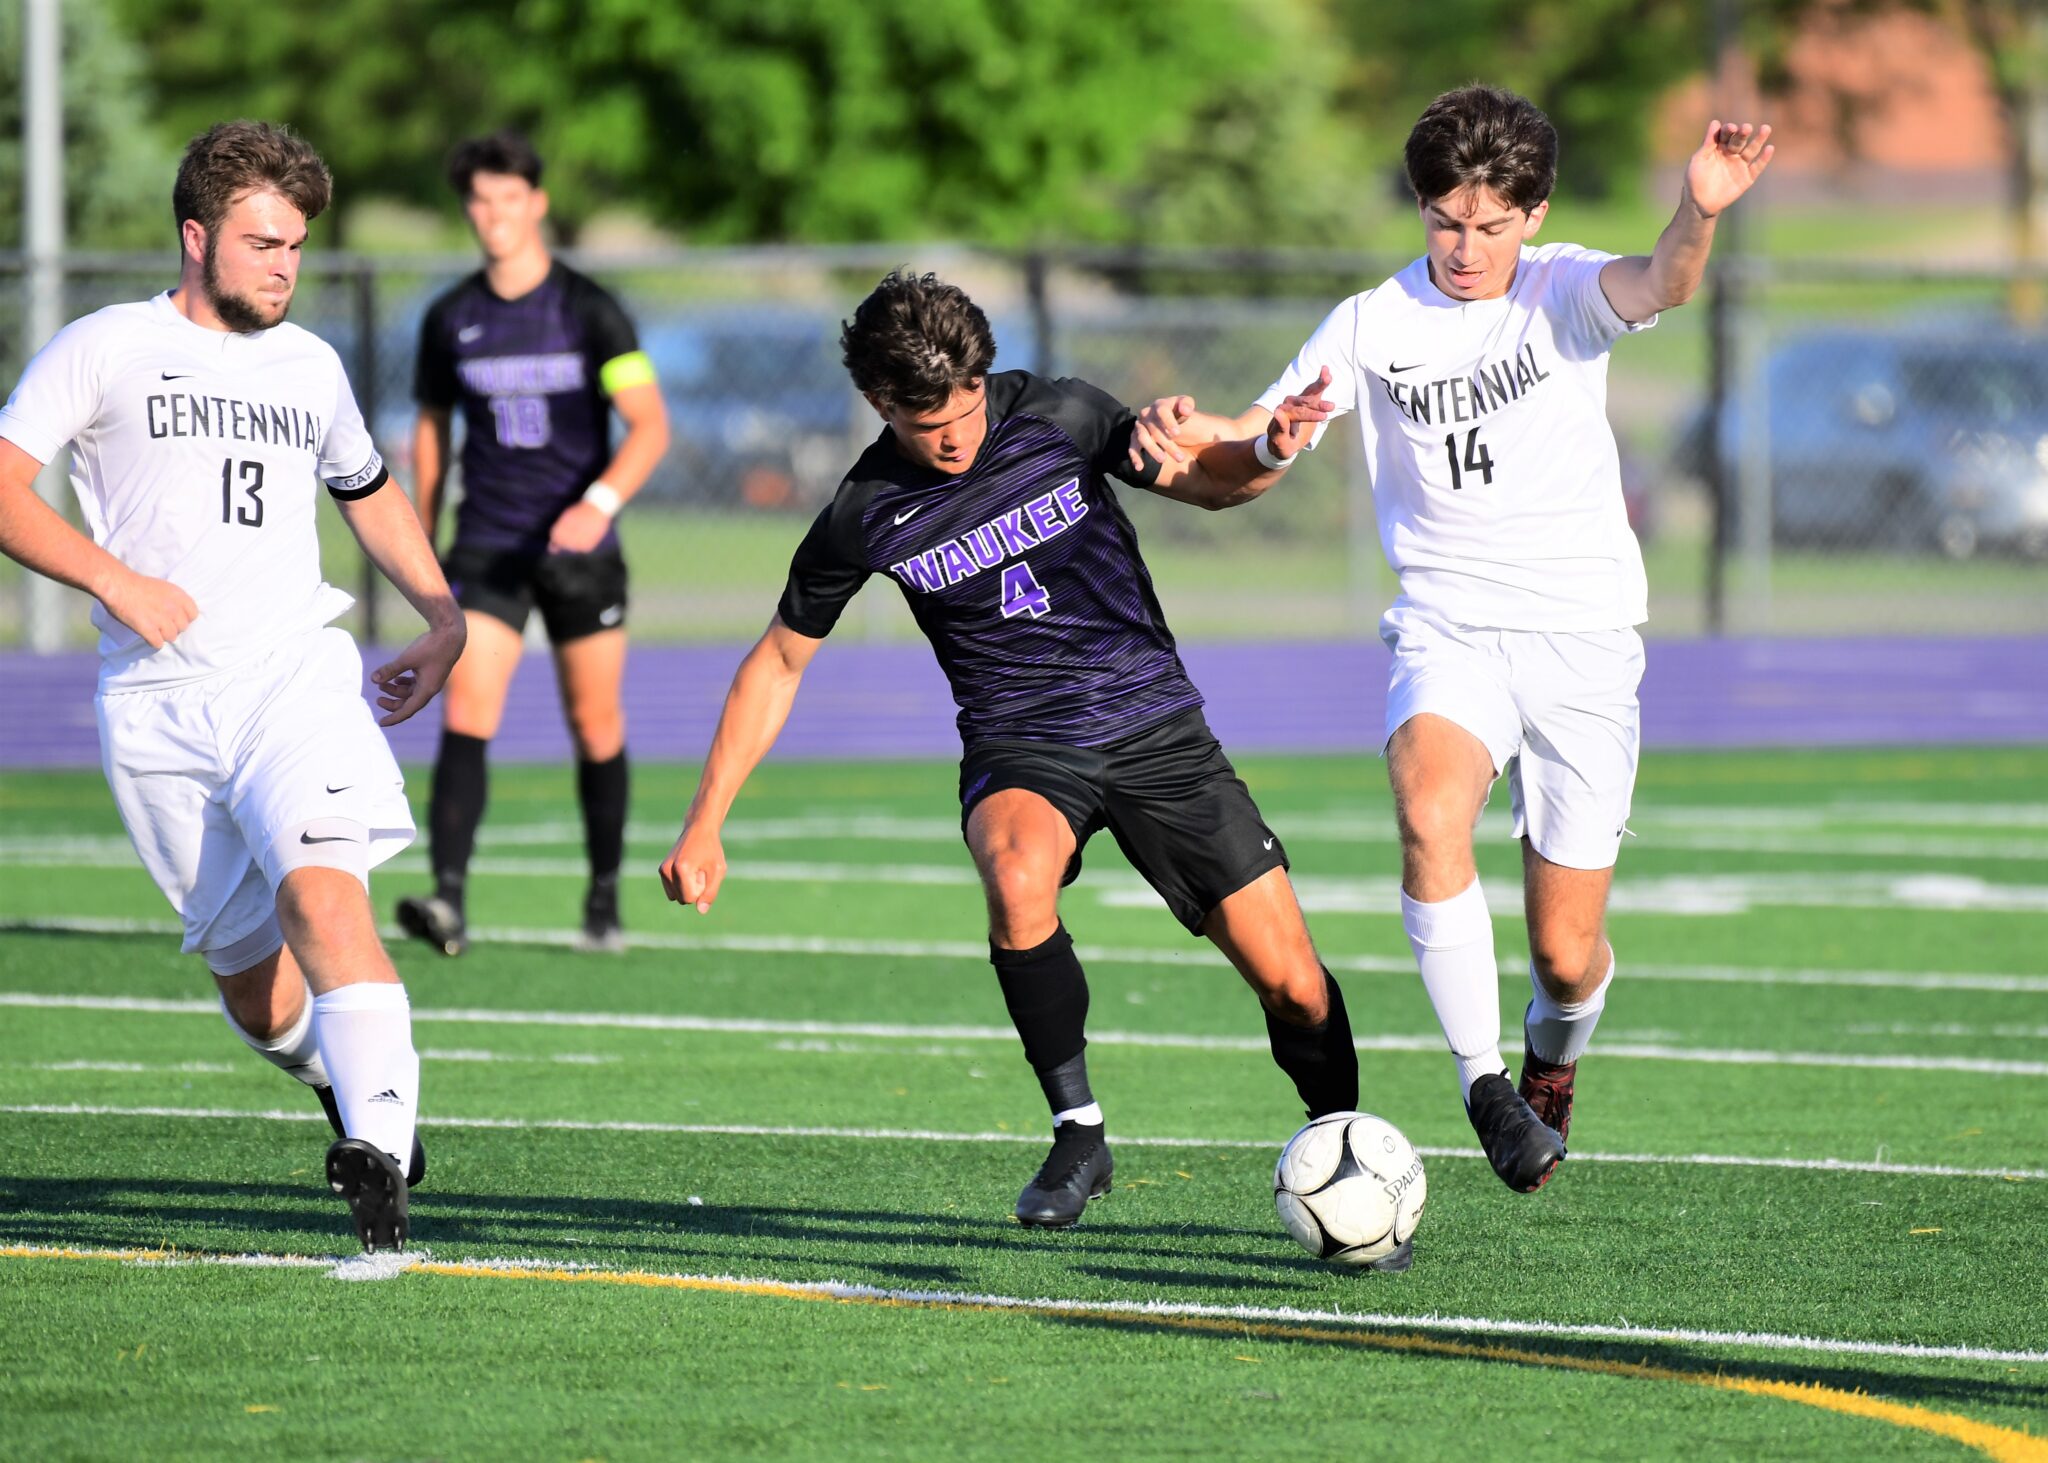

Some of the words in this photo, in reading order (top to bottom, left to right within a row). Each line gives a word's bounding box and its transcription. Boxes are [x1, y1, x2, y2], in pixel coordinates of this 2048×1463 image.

[344, 454, 381, 488] CAPTA
[1445, 425, 1494, 490] 14
[222, 458, 264, 528] 13
[890, 477, 1089, 593] WAUKEE
[1000, 560, 1051, 619] 4
